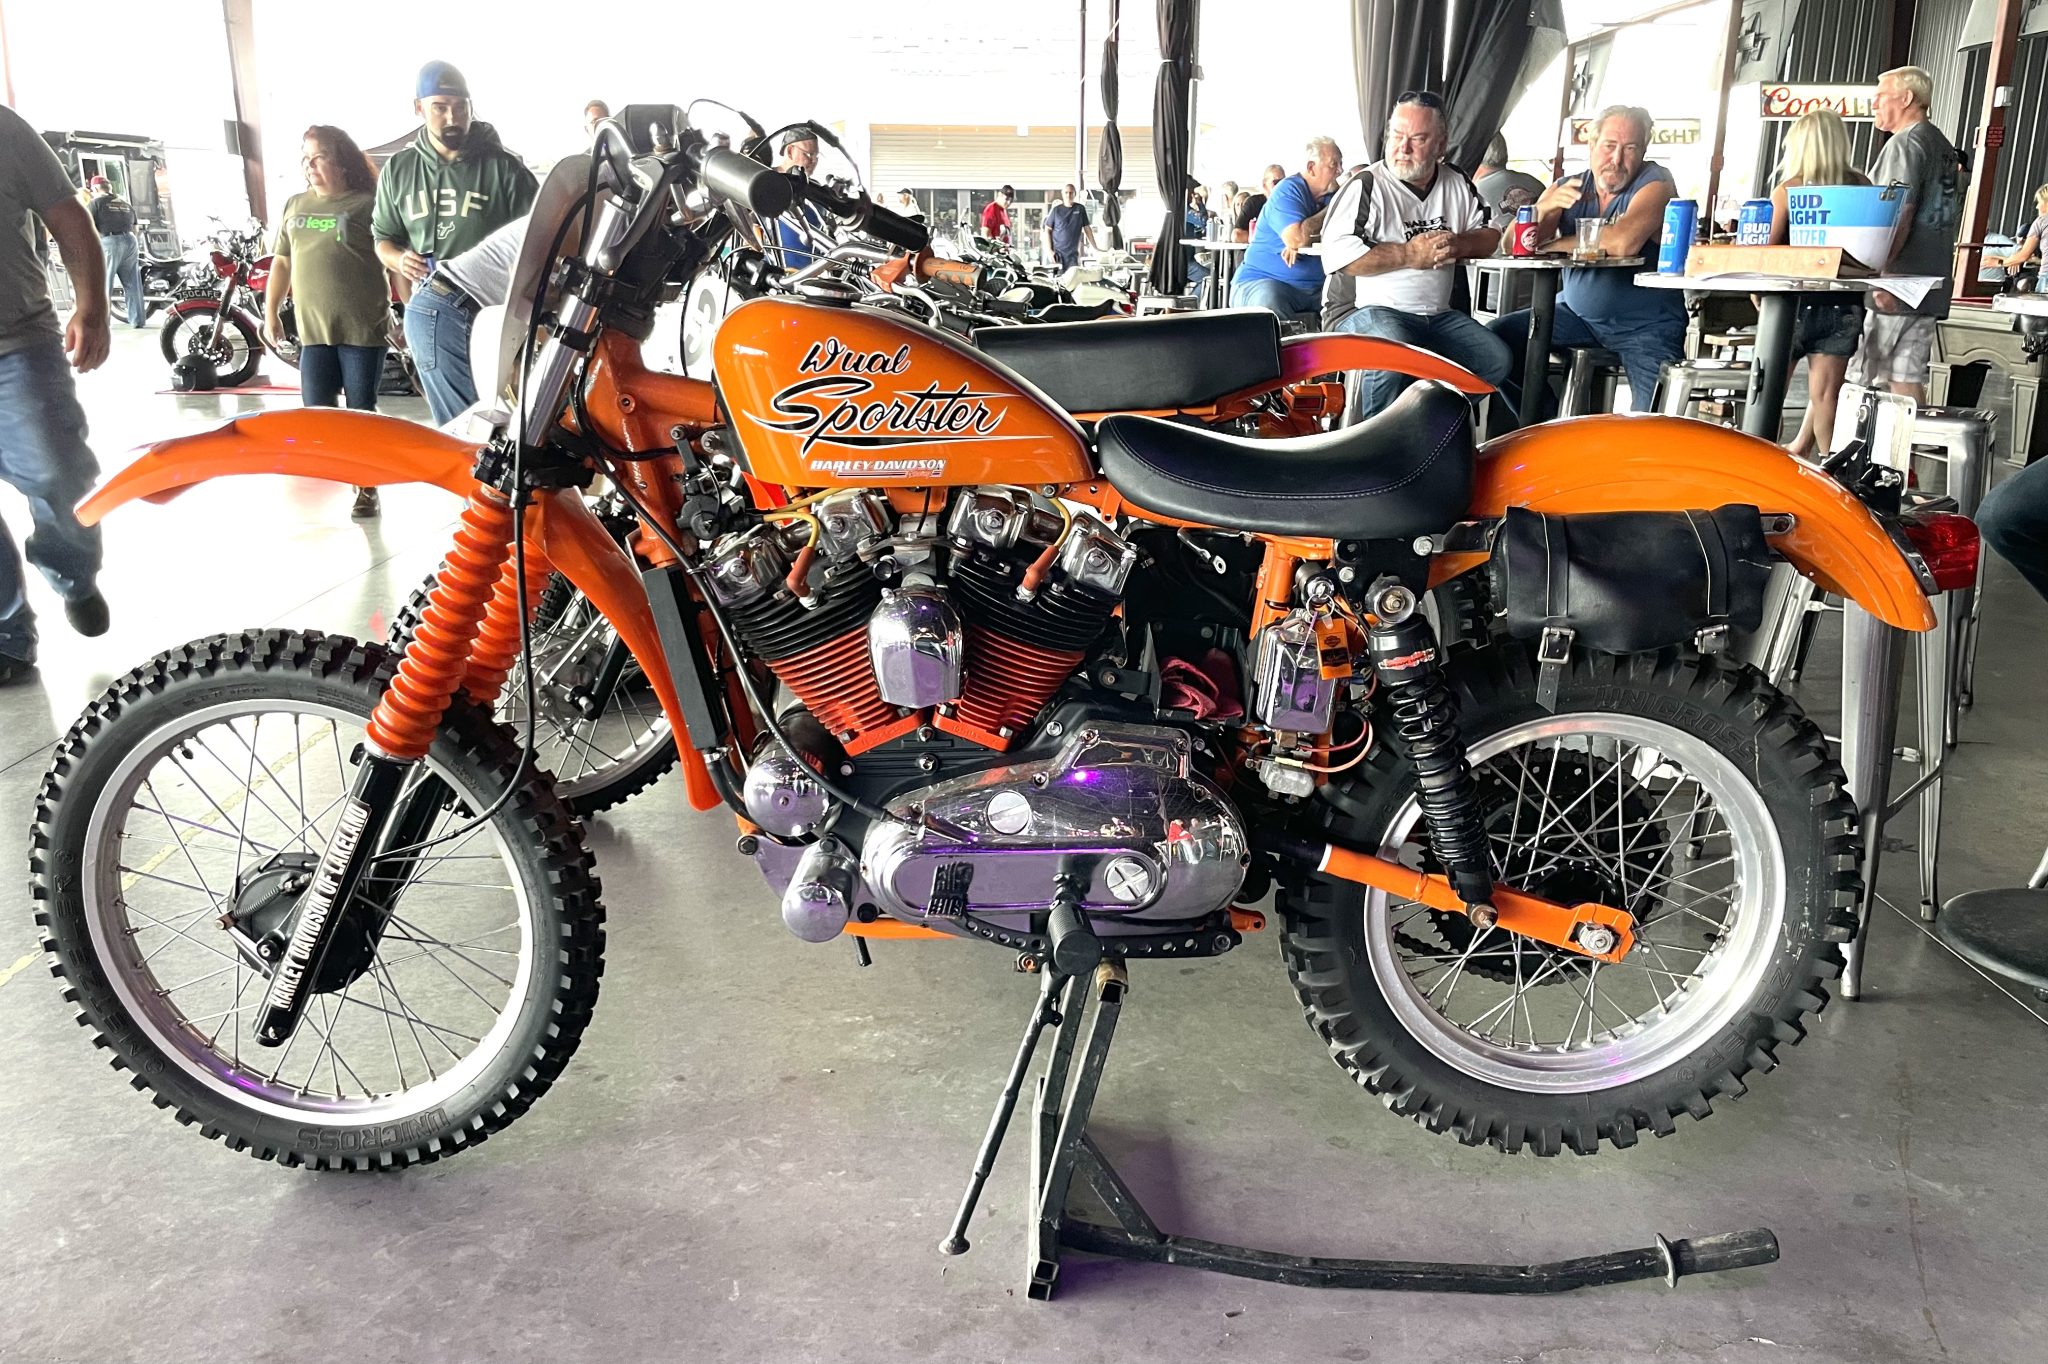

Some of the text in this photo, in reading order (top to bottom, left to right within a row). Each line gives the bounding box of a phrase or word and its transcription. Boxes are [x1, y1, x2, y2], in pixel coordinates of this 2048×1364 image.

[1763, 86, 1849, 117] Coors
[1652, 128, 1700, 145] IGHT
[405, 188, 489, 221] USF
[1790, 194, 1823, 209] BUD
[1790, 210, 1831, 225] IGHT
[1743, 222, 1771, 235] BUD
[798, 336, 911, 375] Dual
[742, 375, 1045, 459] Sportster
[1595, 687, 1758, 764] UNICROSS
[268, 802, 370, 1010] HARLEY DAVIDSON OF LAKELAND
[296, 1107, 451, 1152] UNICROSS
